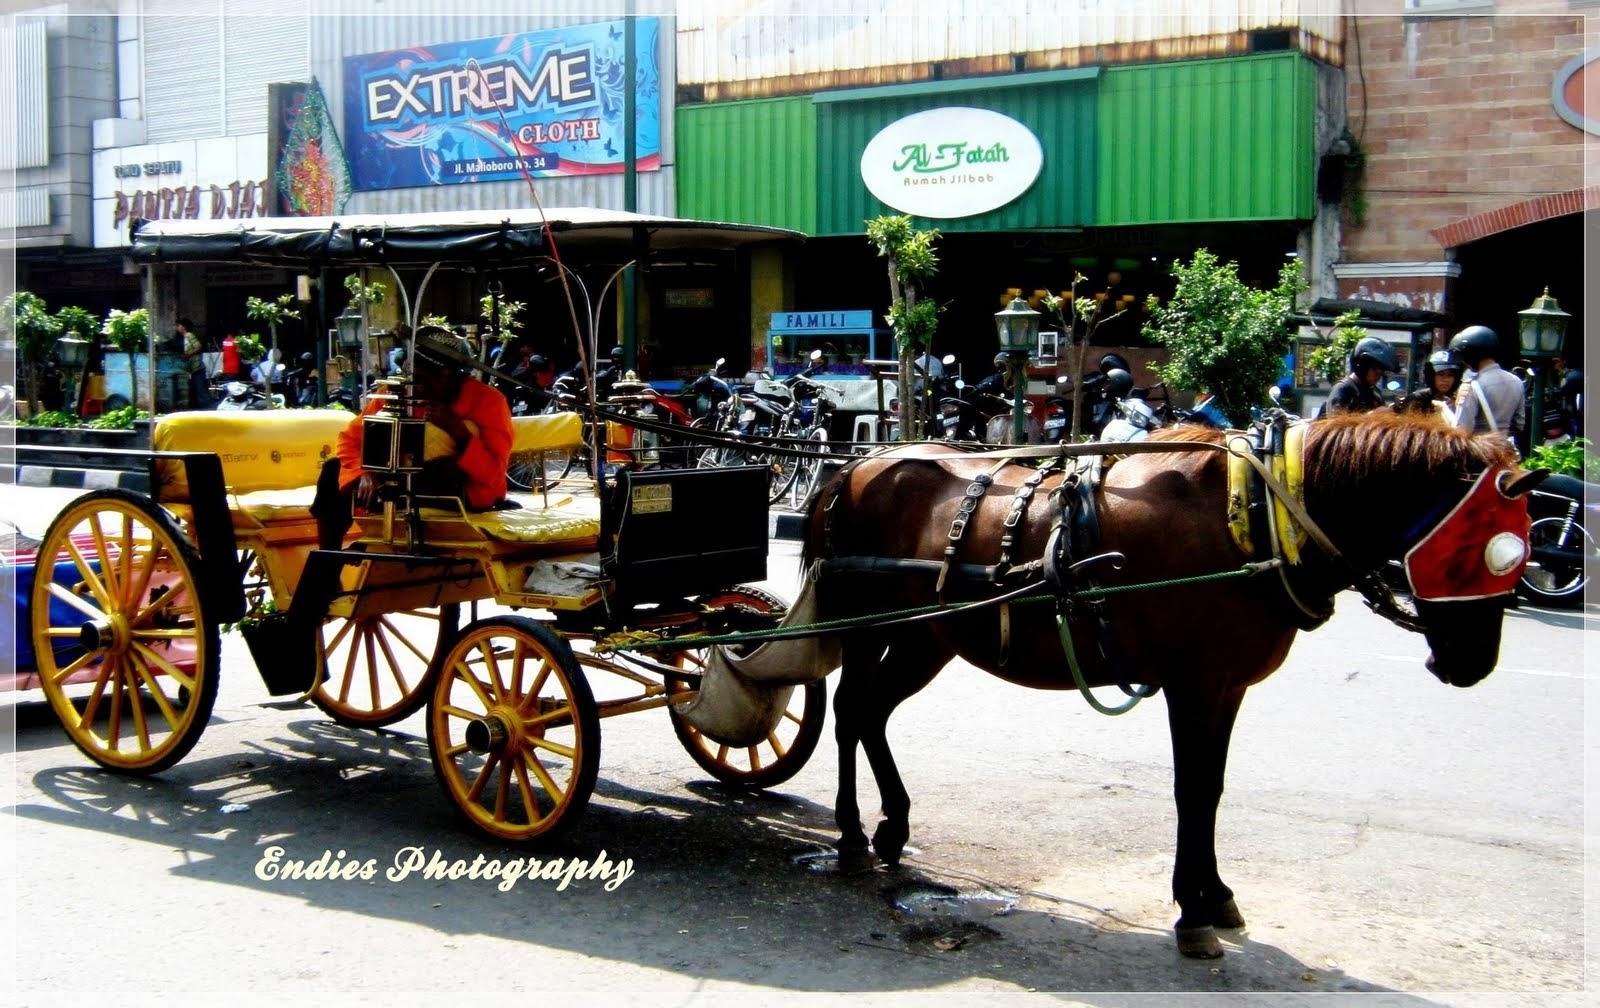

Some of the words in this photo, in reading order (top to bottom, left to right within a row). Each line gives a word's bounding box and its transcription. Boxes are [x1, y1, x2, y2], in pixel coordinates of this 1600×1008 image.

[365, 51, 595, 123] EXTREME
[518, 118, 600, 145] CLOTH
[114, 164, 141, 178] TOKO
[143, 160, 182, 176] SEPATU
[466, 160, 513, 173] Malioboro
[533, 157, 546, 168] 34
[904, 176, 946, 186] Rumah
[950, 173, 994, 184] Jilbab
[786, 313, 846, 328] FAMILI
